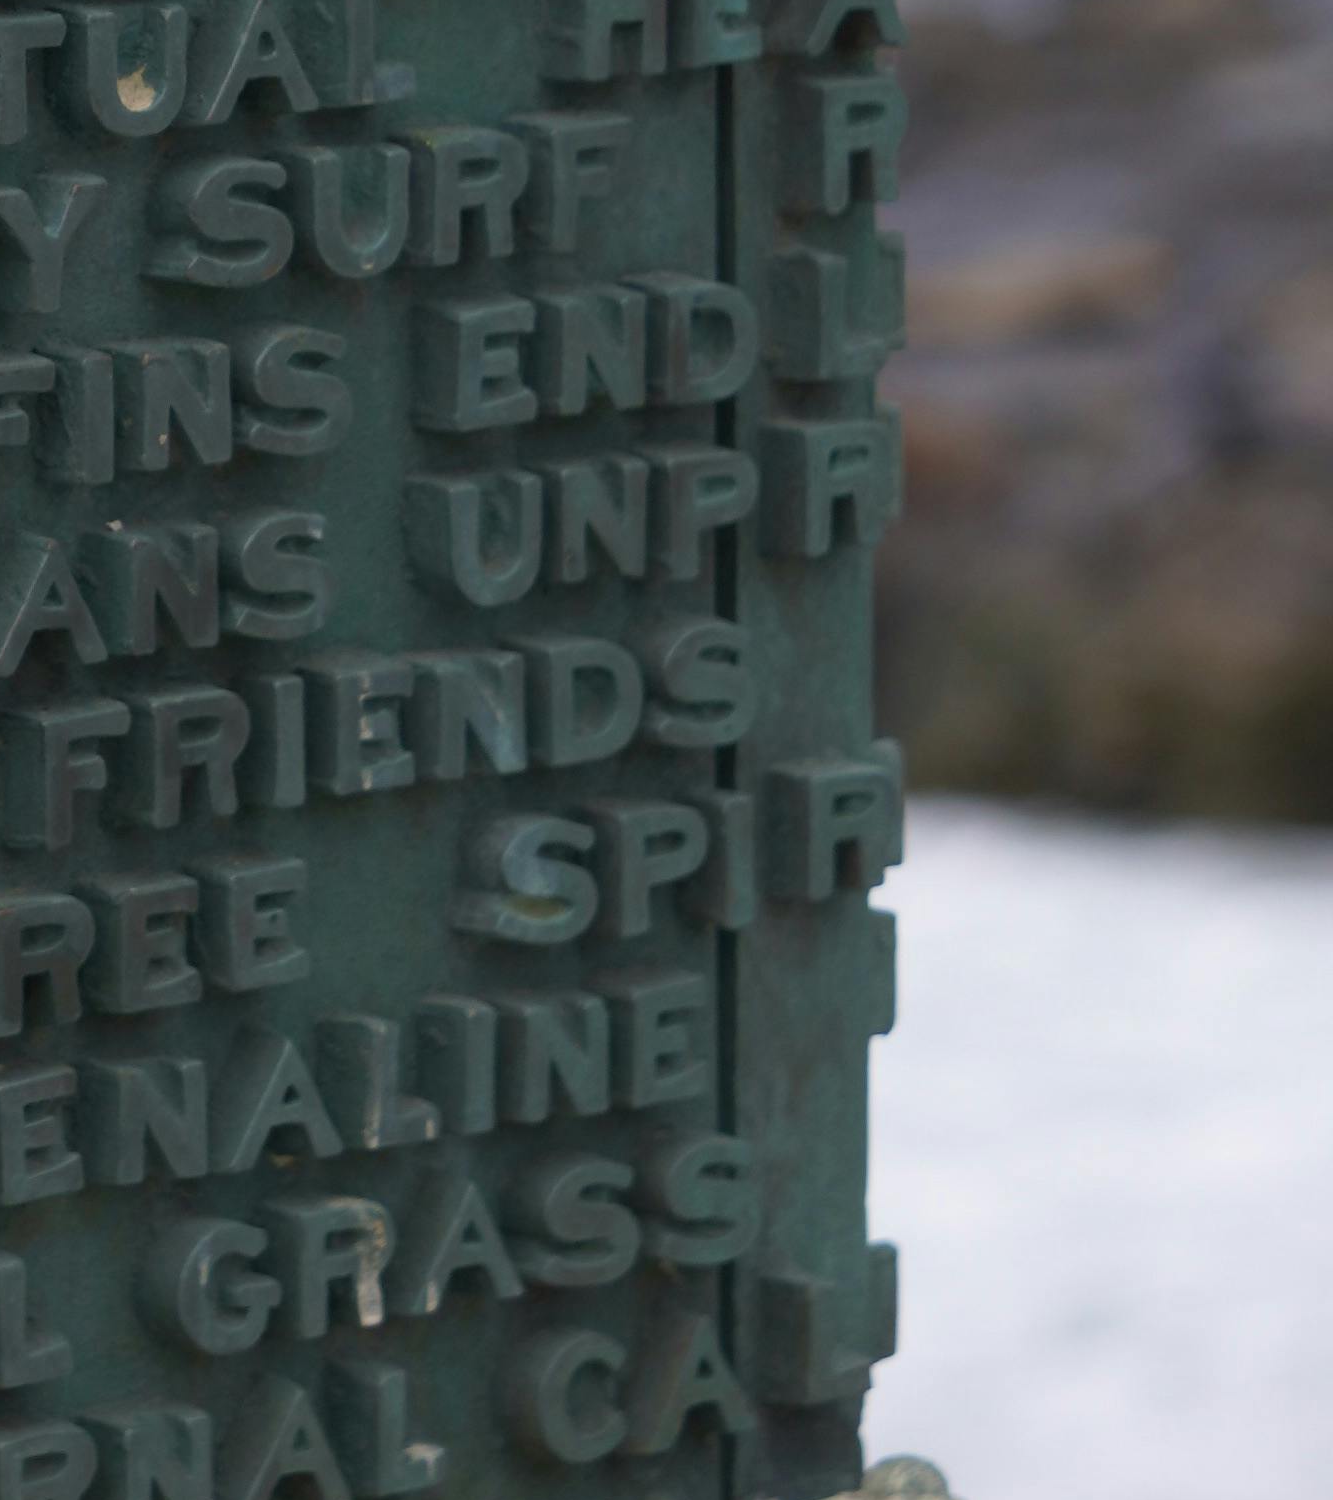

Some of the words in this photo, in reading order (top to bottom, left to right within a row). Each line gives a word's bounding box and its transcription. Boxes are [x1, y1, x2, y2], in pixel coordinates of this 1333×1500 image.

[143, 112, 633, 290] SURF
[1, 615, 758, 855] FRIENDS
[173, 1132, 758, 1358] GRASS
